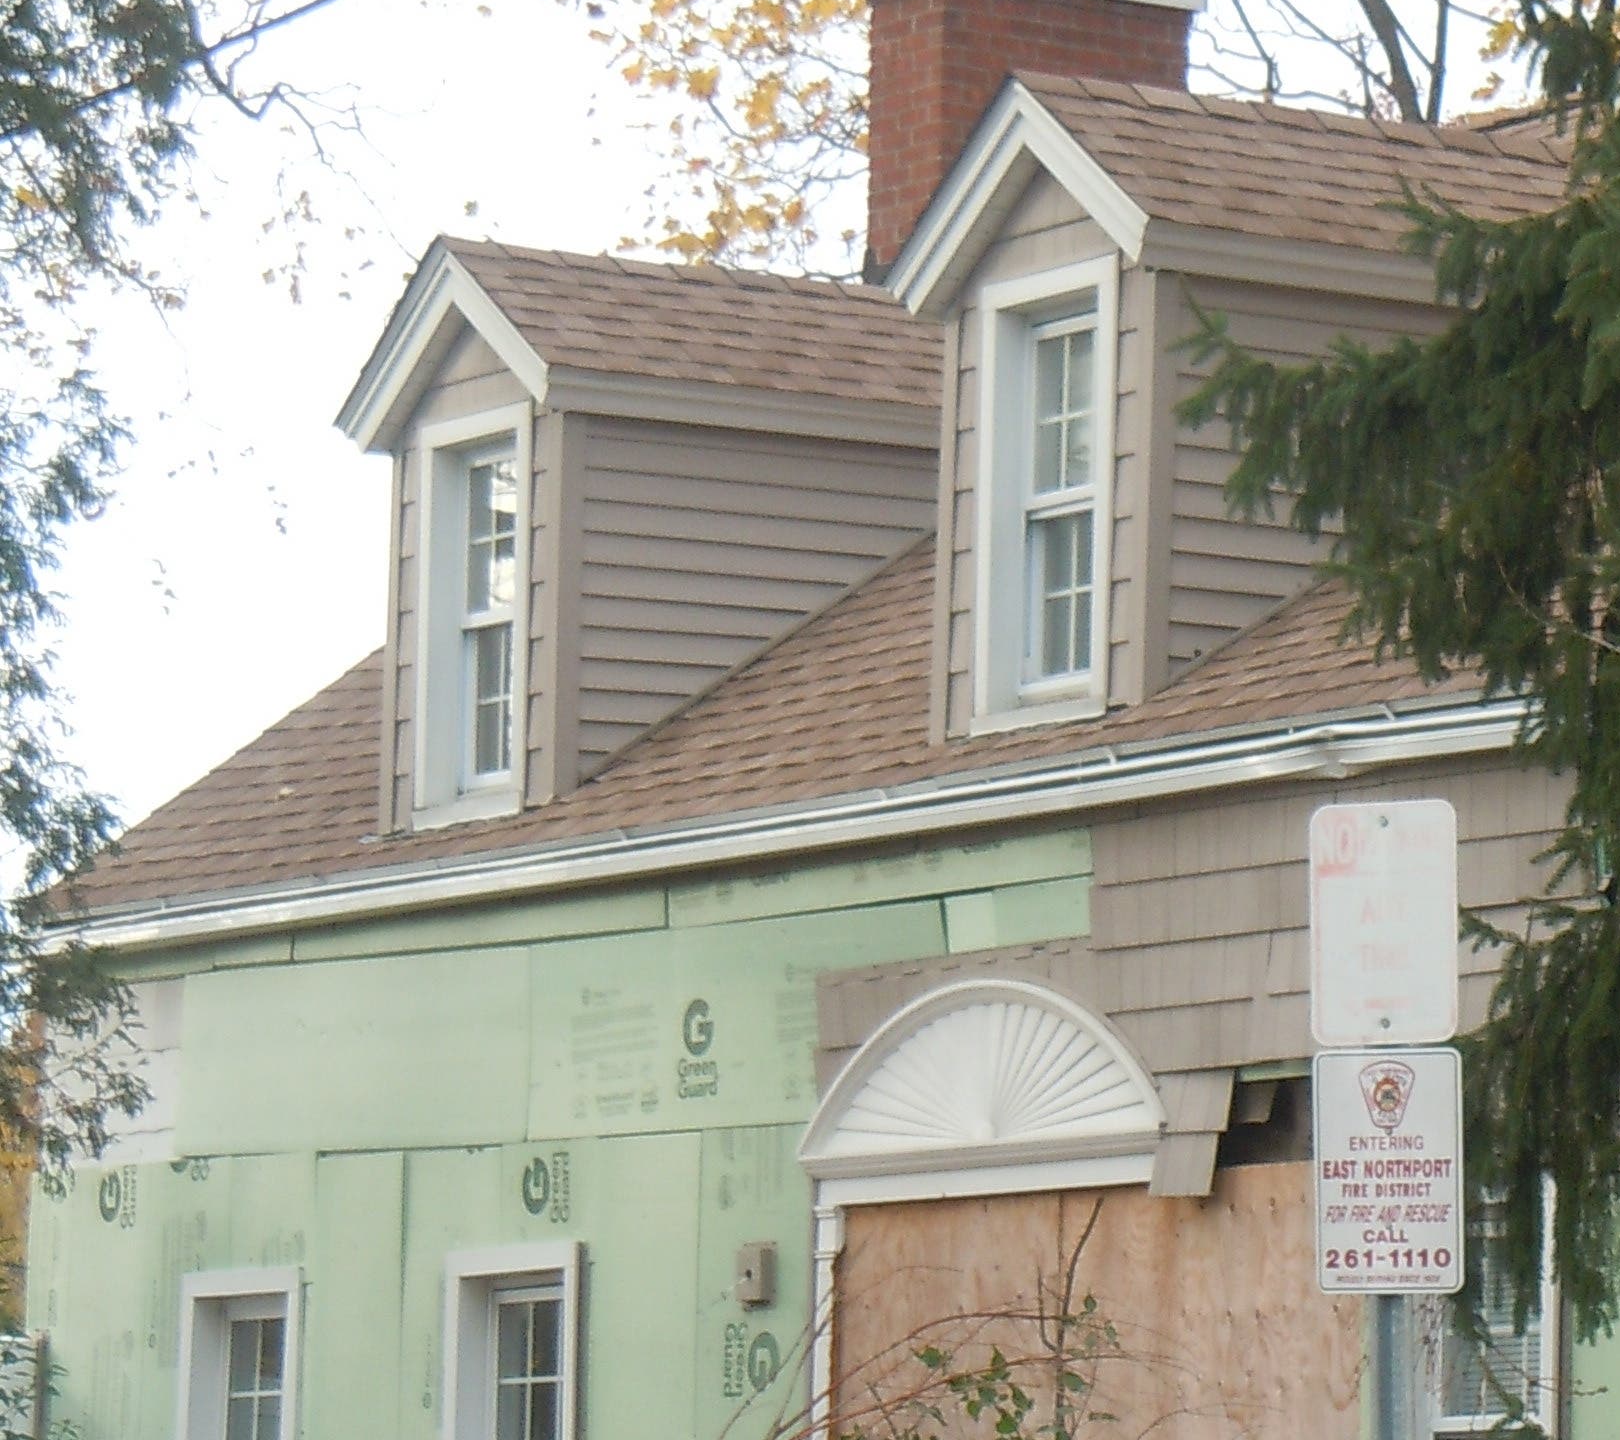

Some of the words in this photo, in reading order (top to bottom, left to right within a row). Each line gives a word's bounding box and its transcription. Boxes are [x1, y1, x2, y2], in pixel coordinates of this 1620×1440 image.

[1349, 1135, 1424, 1152] ENTERING
[1322, 1161, 1357, 1180] EAST
[1363, 1159, 1452, 1179] NORTHPORT
[1342, 1183, 1368, 1198] FIRE
[1375, 1182, 1431, 1198] DISTRICT
[1325, 1205, 1348, 1224] FOR
[1351, 1205, 1376, 1223] FIRE
[1377, 1205, 1402, 1223] AND
[1403, 1204, 1452, 1223] RESCUE
[1362, 1229, 1409, 1244] CALL
[1325, 1248, 1451, 1269] 261-1110
